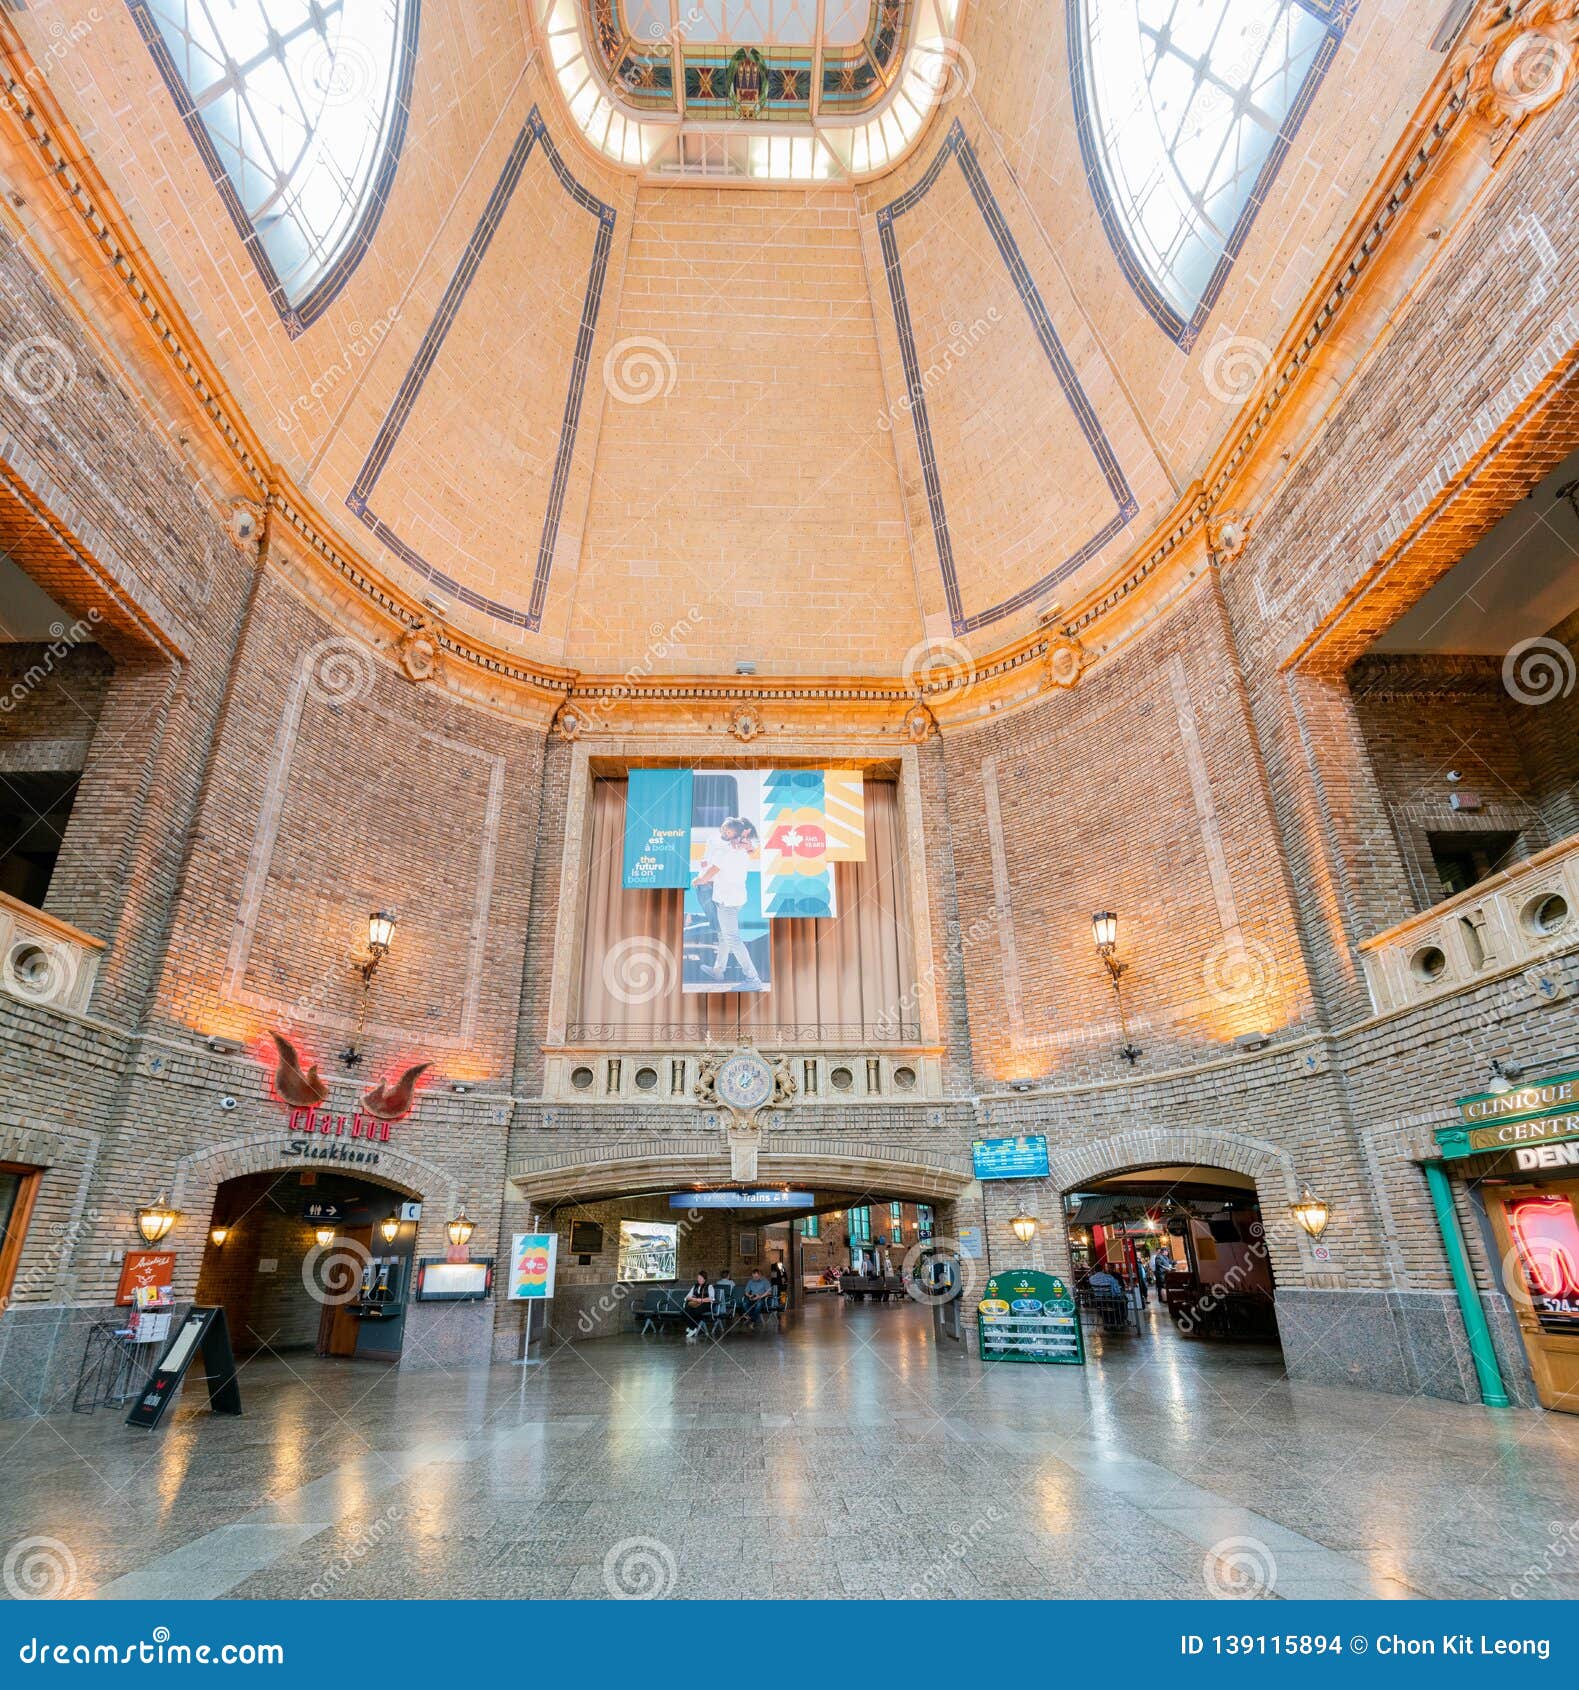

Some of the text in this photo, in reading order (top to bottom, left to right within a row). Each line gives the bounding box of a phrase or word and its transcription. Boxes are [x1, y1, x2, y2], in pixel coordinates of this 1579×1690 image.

[640, 856, 657, 864] the
[635, 862, 665, 871] future
[631, 868, 640, 877] is
[1468, 1083, 1573, 1118] CLINIQUE
[281, 1140, 381, 1165] Steakhouse
[1515, 1141, 1579, 1171] DEN
[742, 1192, 771, 1203] Trains
